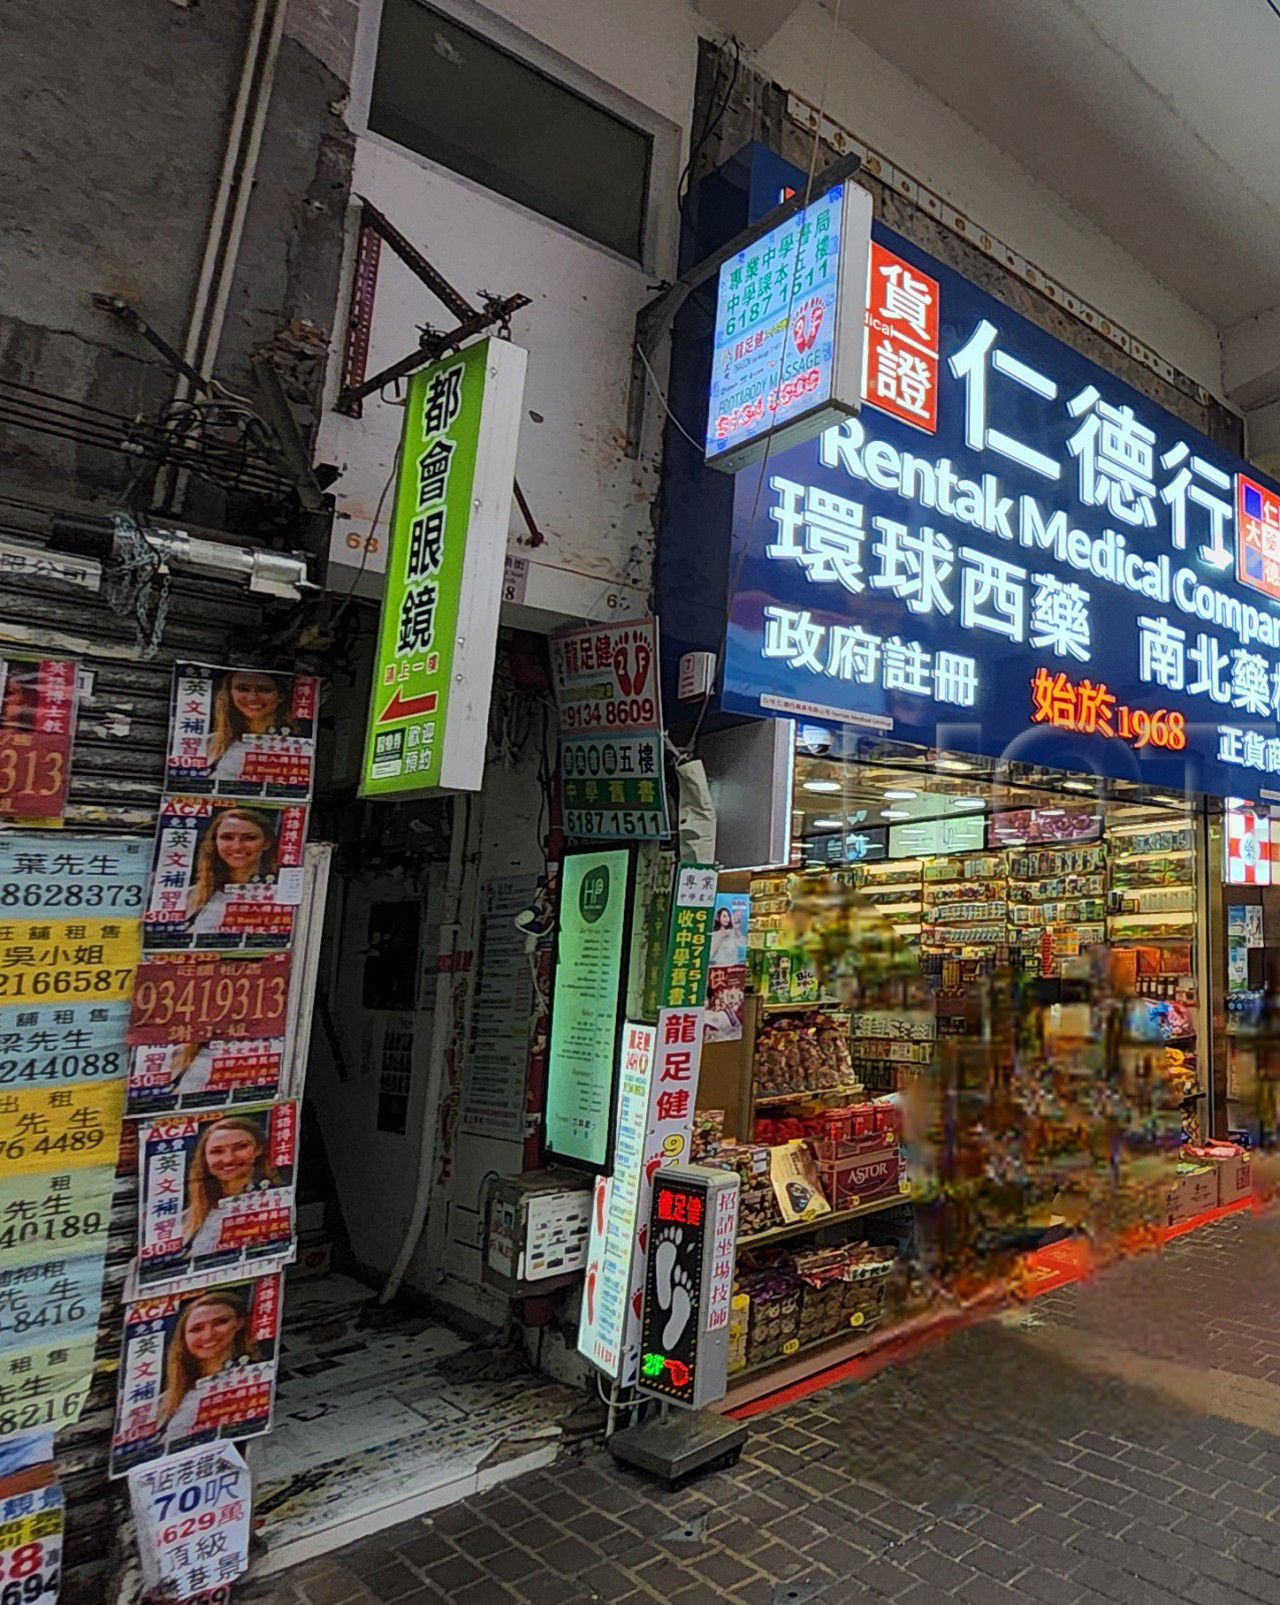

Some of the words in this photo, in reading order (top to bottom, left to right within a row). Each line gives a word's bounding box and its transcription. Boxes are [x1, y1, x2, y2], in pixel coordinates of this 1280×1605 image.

[726, 294, 772, 336] 6187
[880, 264, 933, 341] 貨
[877, 340, 932, 420] 證
[948, 317, 1234, 571] 仁德行
[396, 364, 464, 657] 都會眼鏡
[819, 418, 1015, 541] Rentak
[1018, 493, 1173, 604] Medical
[765, 474, 1092, 663] 環球西藥
[760, 606, 978, 707] 政府註冊
[178, 680, 208, 757] 英文補習
[605, 697, 654, 726] 8609
[1030, 667, 1188, 753] 始於1968
[619, 742, 655, 775] 五樓
[162, 802, 211, 818] ACA
[10, 852, 121, 877] 葉先生
[158, 830, 193, 910] 英文補習
[0, 882, 144, 908] 8628373
[687, 910, 708, 1005] 61871511
[0, 968, 133, 996] 2166587
[135, 977, 286, 1028] 93419313
[0, 1052, 121, 1085] 244088
[656, 1013, 699, 1123] 龍足健
[13, 1106, 102, 1139] 先生
[32, 1128, 105, 1157] 4489
[146, 1122, 197, 1141] ACA
[152, 1153, 182, 1241] 英文補習
[846, 1162, 889, 1185] ASTOR
[12, 1298, 88, 1335] 8416
[127, 1297, 178, 1324] ACA
[126, 1336, 161, 1426] 英文補習
[0, 1391, 83, 1436] 8216
